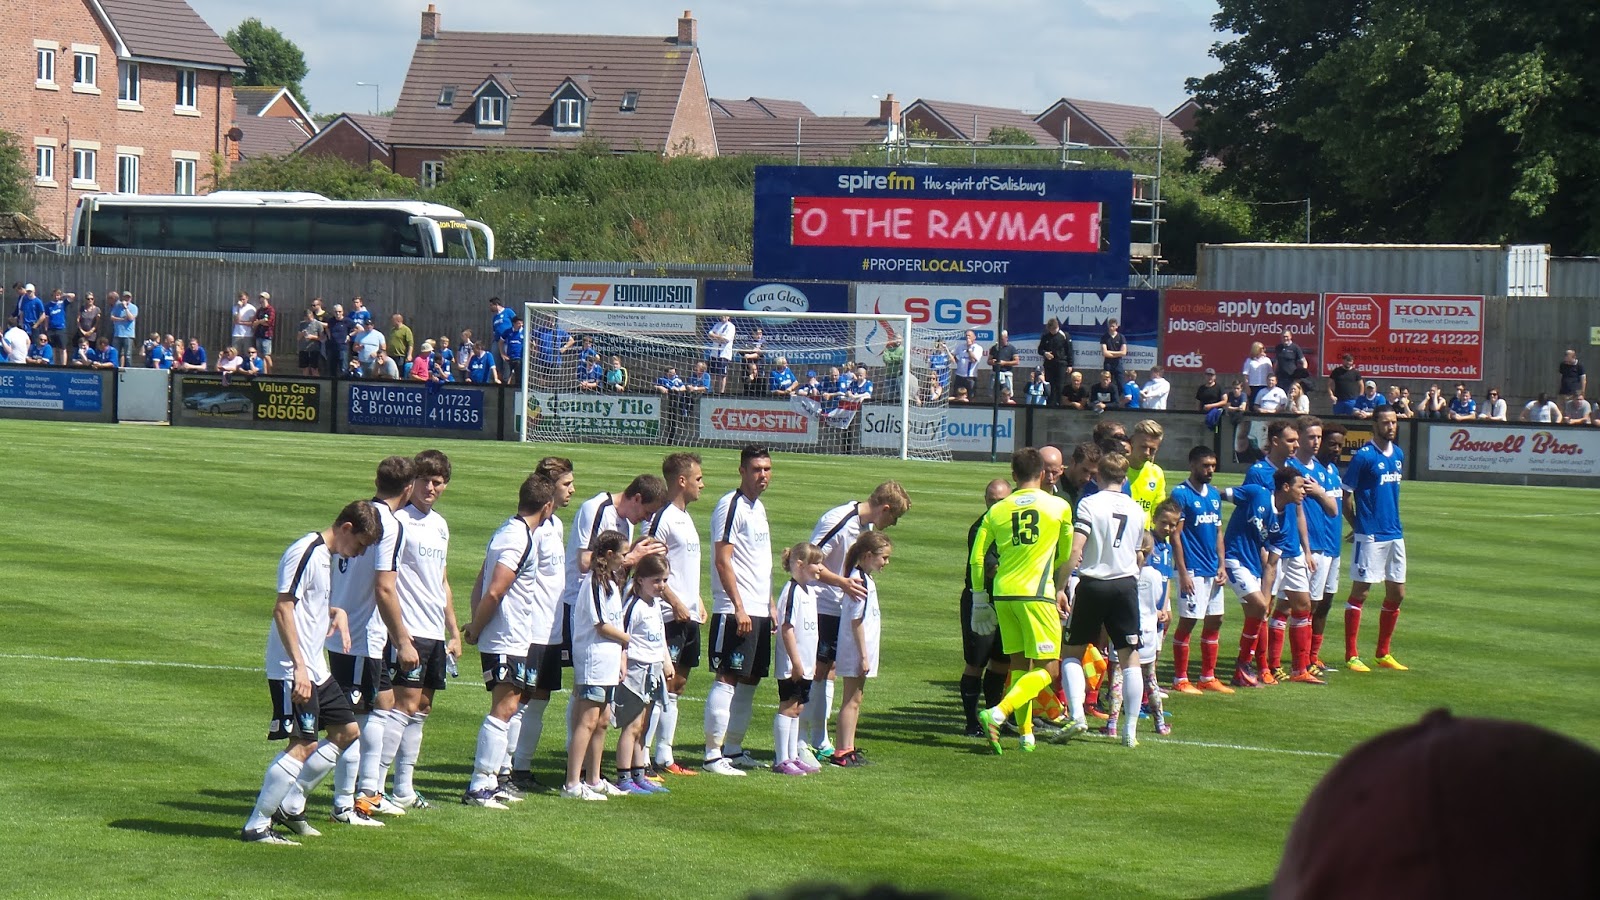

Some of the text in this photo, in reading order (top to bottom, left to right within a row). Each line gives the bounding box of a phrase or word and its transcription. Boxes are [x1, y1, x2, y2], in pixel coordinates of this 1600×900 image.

[838, 170, 1046, 196] spirefm the spirit of Salisbury
[842, 207, 914, 240] THE
[928, 209, 1076, 242] RAYMAC
[862, 257, 1010, 274] #PROPERLOCALSPORT
[613, 284, 693, 304] EDMUNDSON
[748, 290, 806, 307] Cara Glass
[904, 297, 993, 326] SGS
[1194, 303, 1217, 316] delay
[1218, 299, 1263, 318] apply
[1265, 300, 1316, 319] today!
[1336, 302, 1372, 313] August
[1394, 304, 1476, 317] HONDA
[1336, 312, 1372, 321] Motors
[1337, 320, 1371, 331] Honda
[782, 333, 836, 344] Conservatories
[1389, 332, 1429, 345] 01722
[1432, 333, 1480, 346] 412222
[1167, 351, 1203, 368] reds
[258, 382, 288, 394] Value
[291, 384, 317, 395] Cars
[352, 387, 422, 403] Rawlence
[269, 393, 304, 406] 01722
[437, 394, 471, 407] 01722
[546, 395, 653, 416] County Tile
[257, 405, 316, 421] 505050
[352, 400, 422, 416] & Browne
[429, 408, 479, 423] 411535
[622, 419, 646, 428] 600
[728, 412, 803, 430] EVO-STIK
[1011, 508, 1041, 547] 13
[1112, 512, 1129, 549] 7
